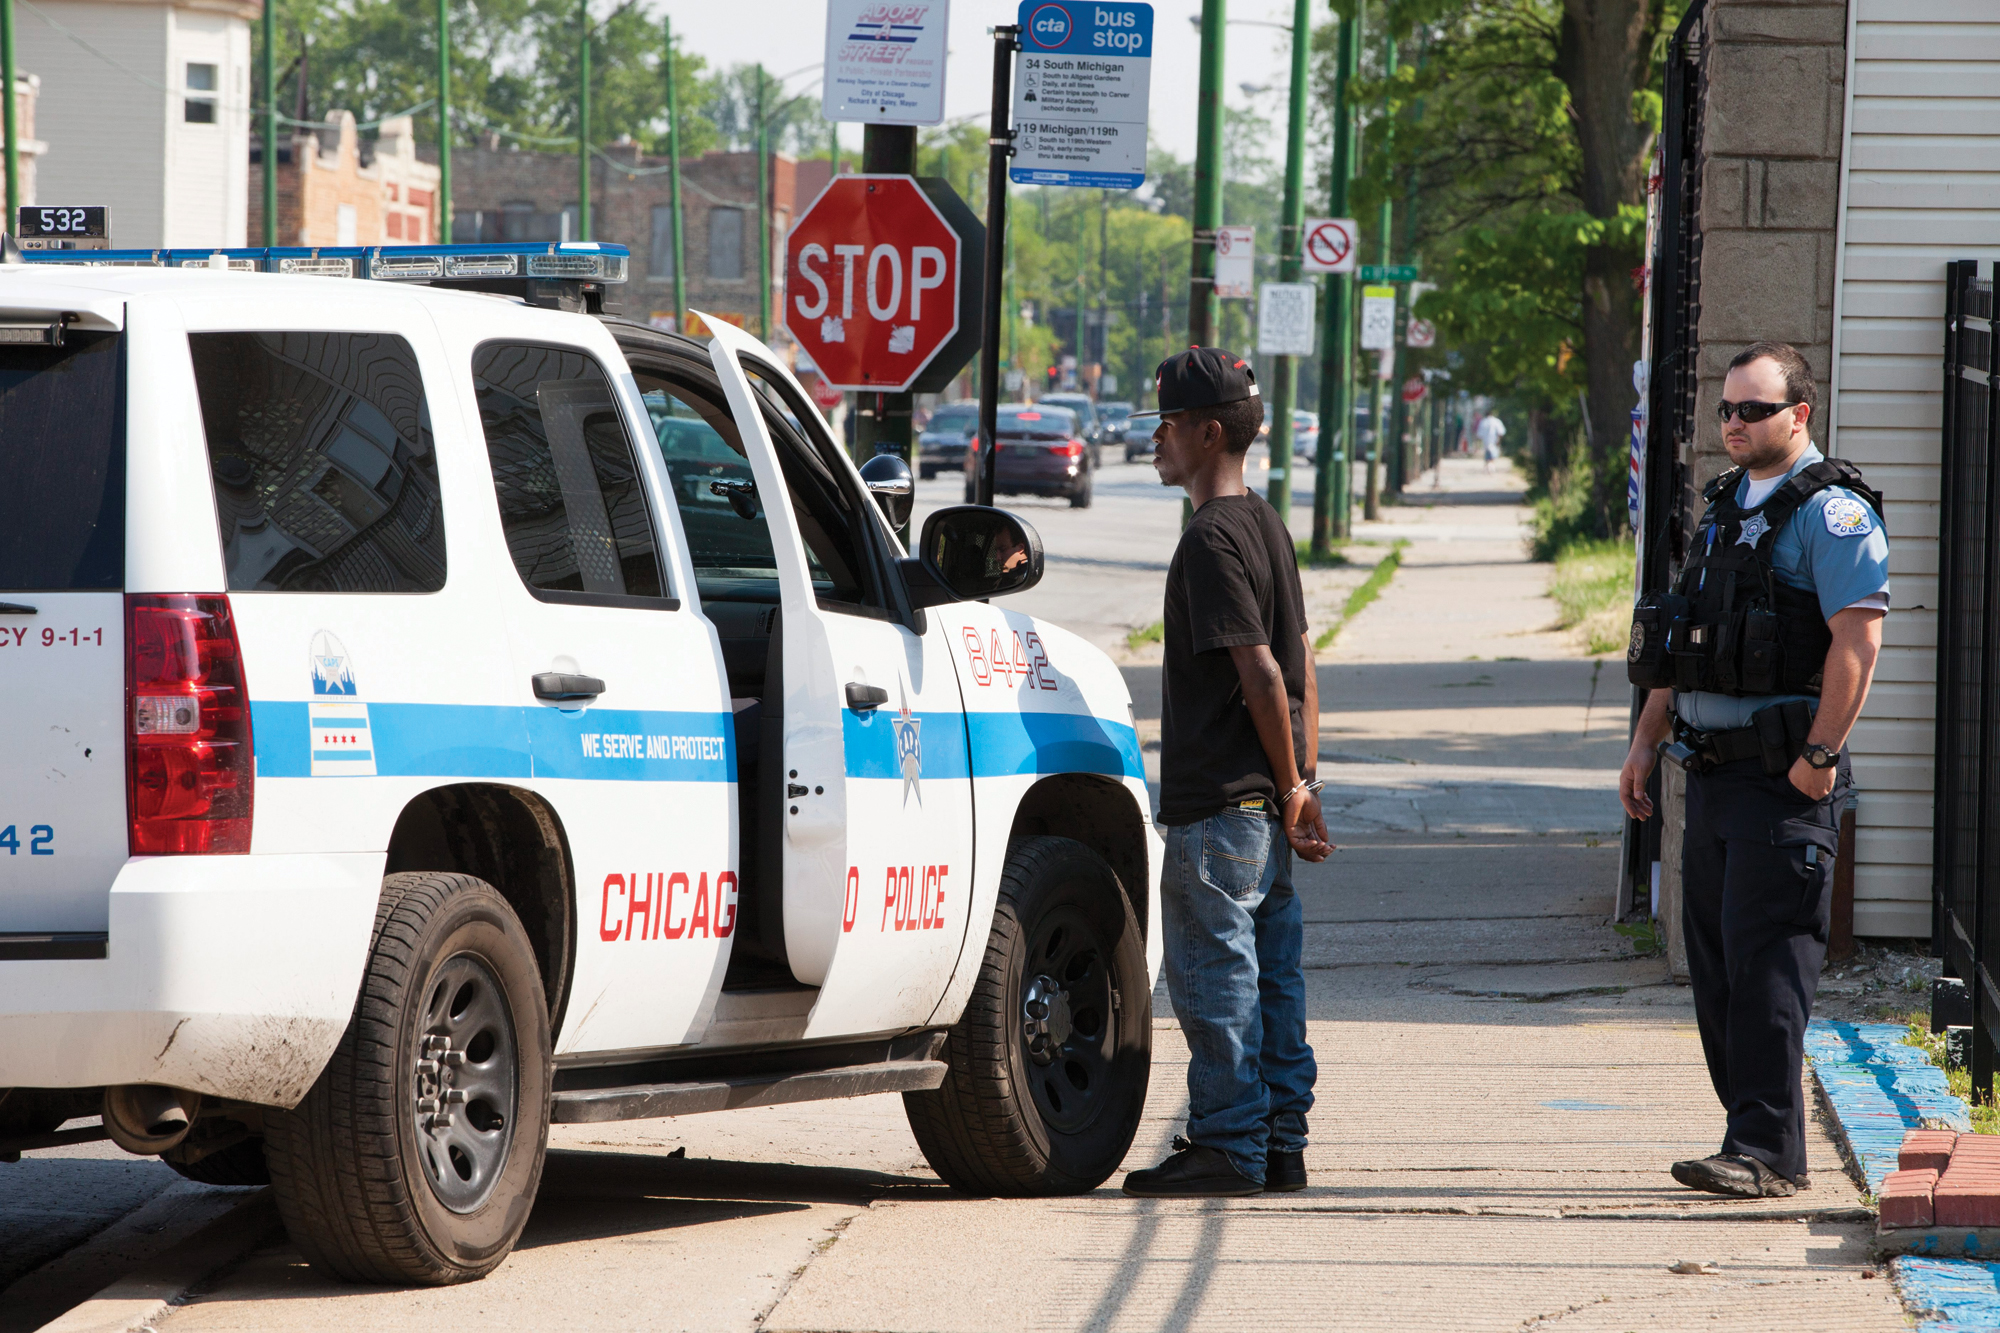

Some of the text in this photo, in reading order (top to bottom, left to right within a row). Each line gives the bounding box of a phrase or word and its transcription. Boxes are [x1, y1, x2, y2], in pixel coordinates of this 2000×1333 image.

[858, 3, 929, 24] ADOPT
[1094, 6, 1136, 28] bus
[875, 17, 891, 40] A
[1036, 18, 1065, 32] cta
[1092, 29, 1143, 54] stop
[838, 42, 912, 64] STREET
[1026, 59, 1125, 74] 34 South Michigan
[1042, 80, 1059, 88] Daily,
[1070, 73, 1093, 81] Altgeld
[861, 89, 873, 97] City
[882, 90, 905, 98] Chicago
[1041, 96, 1095, 106] Military Academy
[1066, 89, 1080, 97] trips
[1016, 123, 1119, 137] 119 Michigan/119th
[1038, 144, 1056, 152] Daily,
[40, 209, 86, 231] 532
[794, 243, 947, 322] STOP
[1832, 522, 1868, 533] POLICE
[41, 627, 102, 647] 9-1-1
[323, 658, 339, 667] CAPS
[962, 626, 1058, 691] 8442
[580, 733, 725, 760] WE SERVE AND PROTECT
[900, 730, 919, 759] CAPS
[0, 825, 54, 855] 42
[881, 865, 949, 933] POLICE
